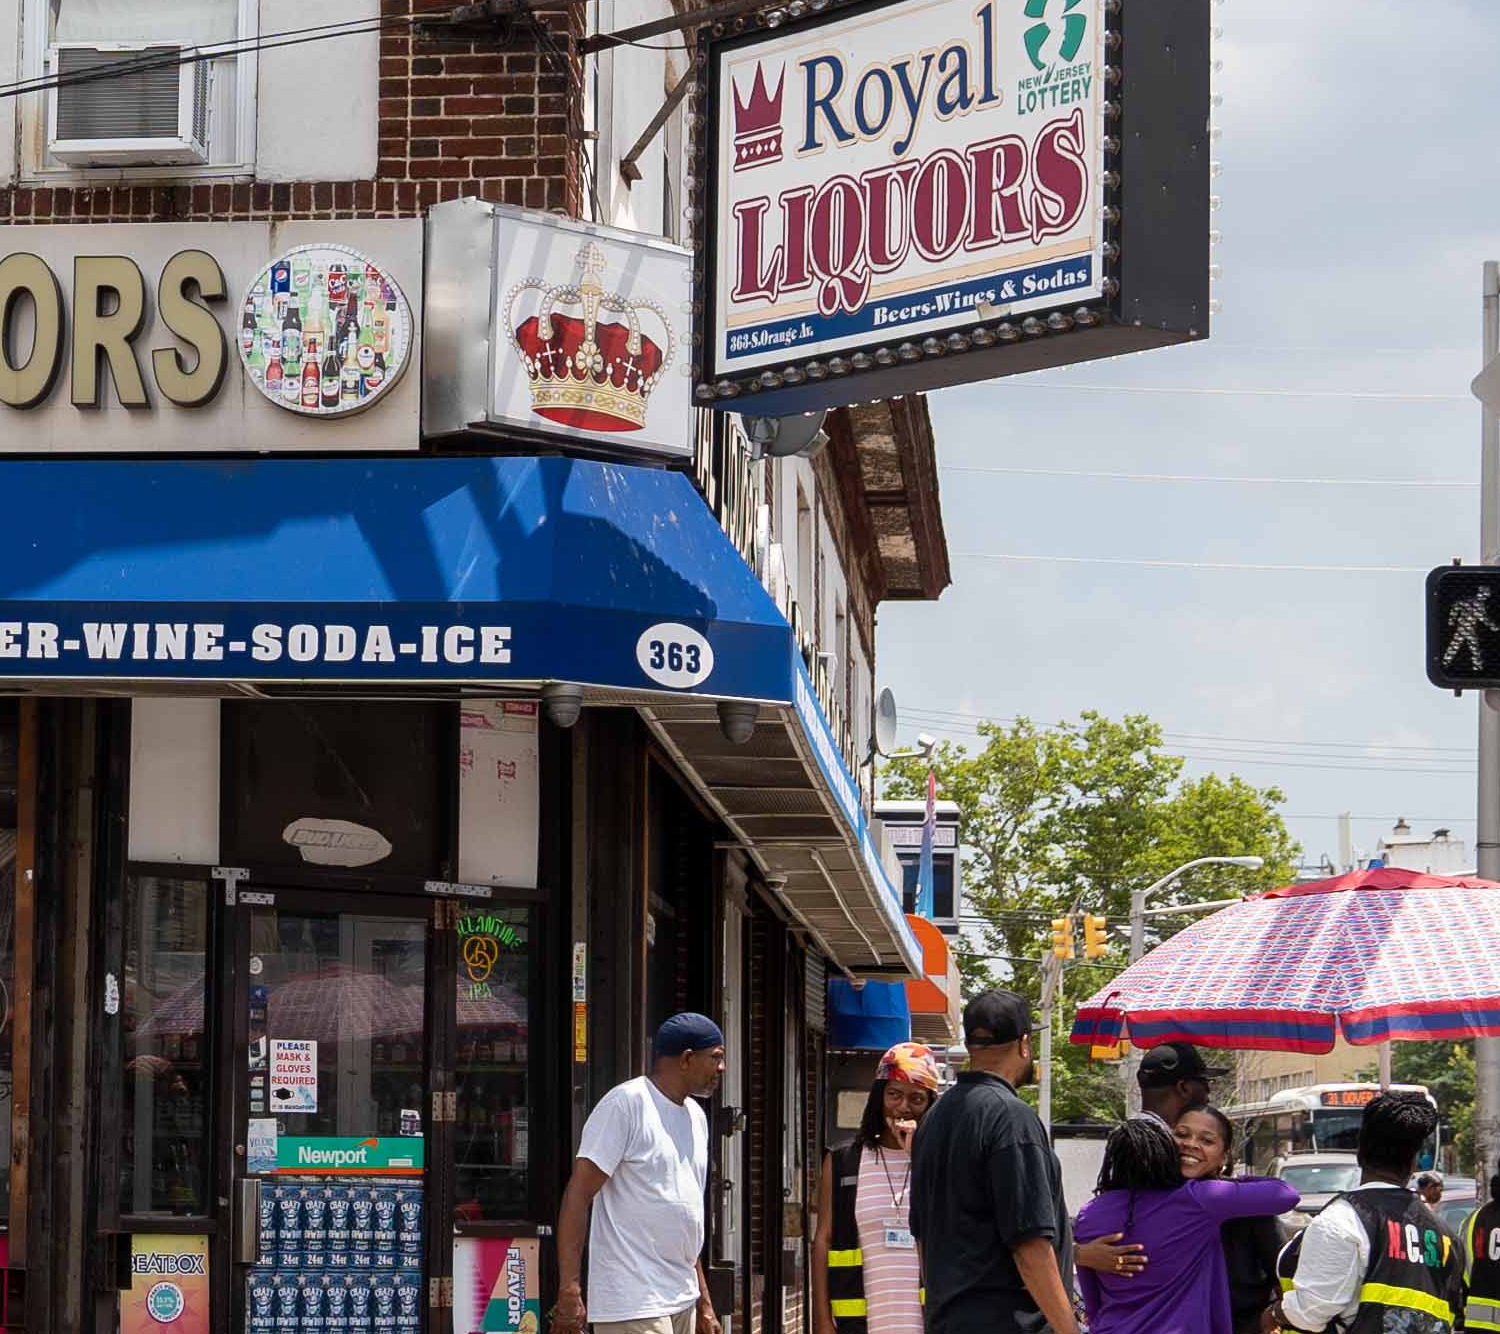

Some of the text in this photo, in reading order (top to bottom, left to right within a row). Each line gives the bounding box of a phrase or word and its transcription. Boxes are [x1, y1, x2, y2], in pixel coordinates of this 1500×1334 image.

[798, 2, 999, 156] Royal
[1018, 62, 1091, 91] NEW JERSEY
[1018, 76, 1092, 115] LOTTERY
[732, 108, 1088, 317] LIQUORS
[873, 266, 1087, 326] Beers-Wines & Sodas
[649, 640, 701, 674] 363
[457, 915, 524, 949] LLANTINE
[275, 1053, 311, 1062] MASK &
[276, 1042, 311, 1051] PLEASE
[271, 1076, 316, 1085] REQUIRED
[276, 1064, 312, 1073] GLOVES
[298, 1146, 367, 1168] Newport
[507, 1246, 520, 1325] FLAVOR
